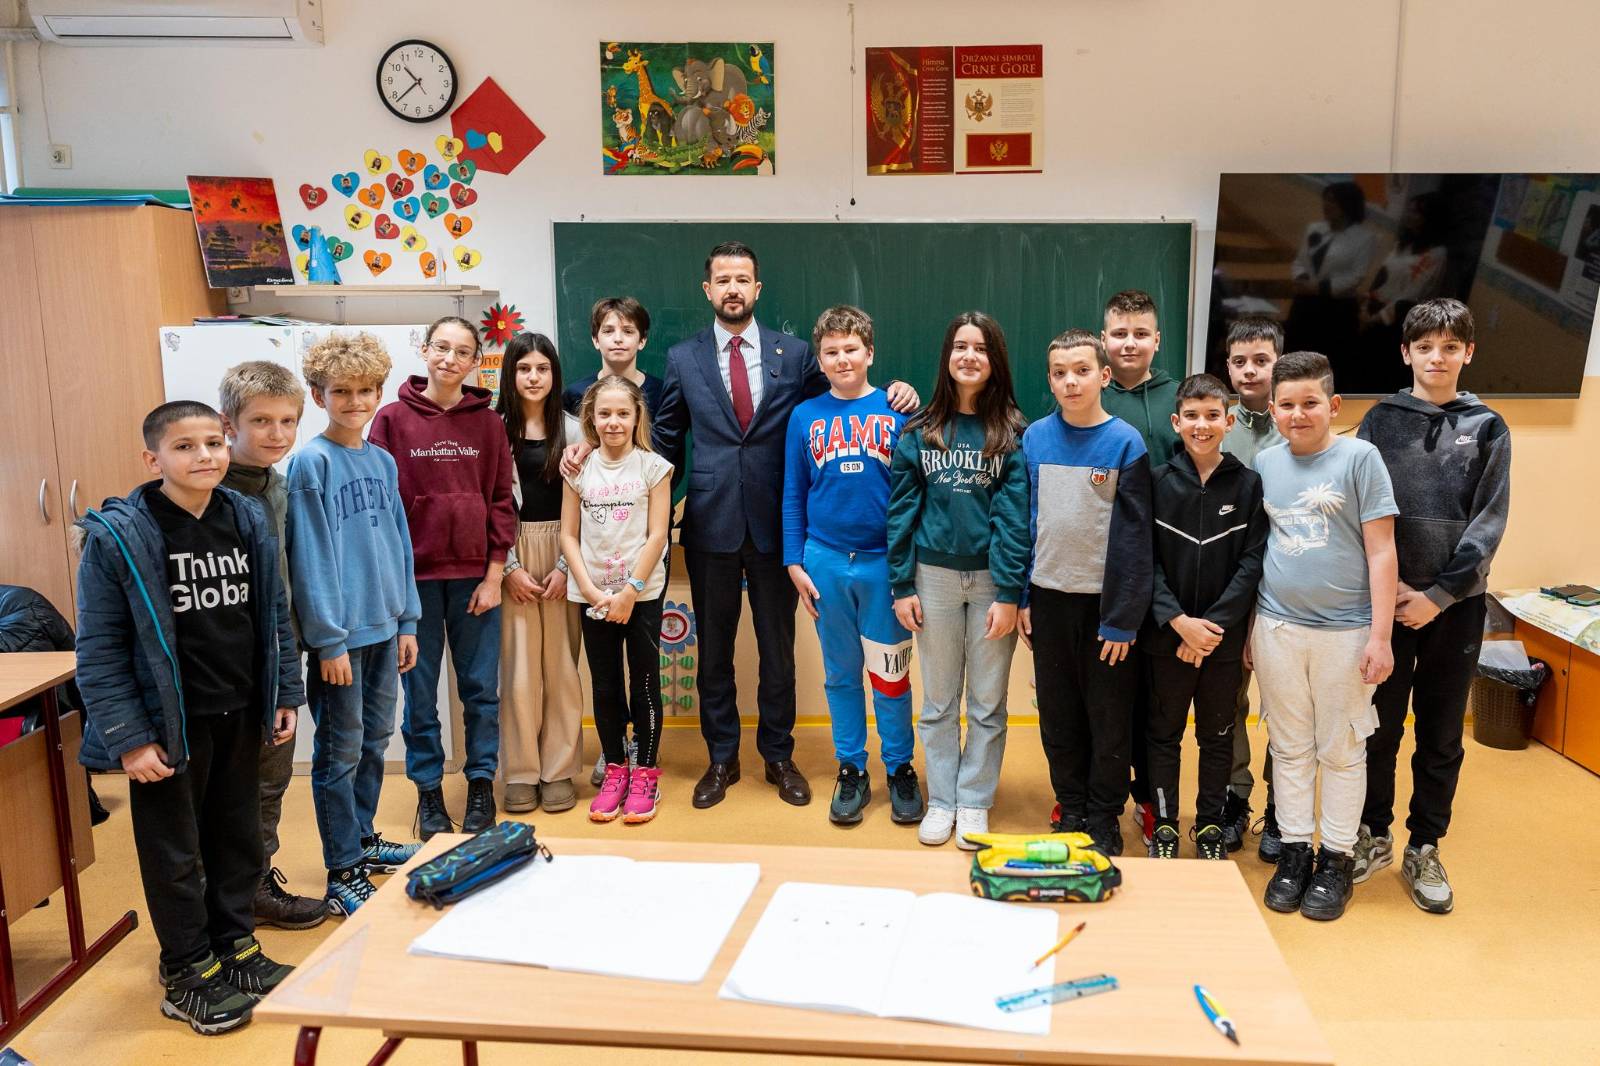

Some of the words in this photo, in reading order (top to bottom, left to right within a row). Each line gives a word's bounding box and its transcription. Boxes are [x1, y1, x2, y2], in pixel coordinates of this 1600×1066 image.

[401, 53, 409, 61] 11
[414, 50, 423, 58] 12
[1002, 54, 1036, 62] SIMBOLI
[430, 55, 434, 63] 1
[392, 64, 401, 72] 10
[438, 64, 444, 73] 2
[961, 63, 997, 75] CRNE
[1000, 62, 1036, 75] GORE
[387, 76, 393, 85] 9
[443, 79, 449, 88] 3
[392, 90, 398, 100] 8
[439, 93, 445, 101] 4
[402, 103, 408, 112] 7
[415, 106, 421, 115] 6
[428, 104, 434, 113] 5
[810, 414, 896, 470] GAME
[410, 447, 457, 458] Manhattan
[458, 446, 480, 459] Valley
[843, 463, 850, 472] IS
[851, 463, 861, 471] ON
[934, 471, 952, 484] New
[952, 469, 976, 487] York
[974, 472, 992, 489] City
[169, 547, 250, 582] Think
